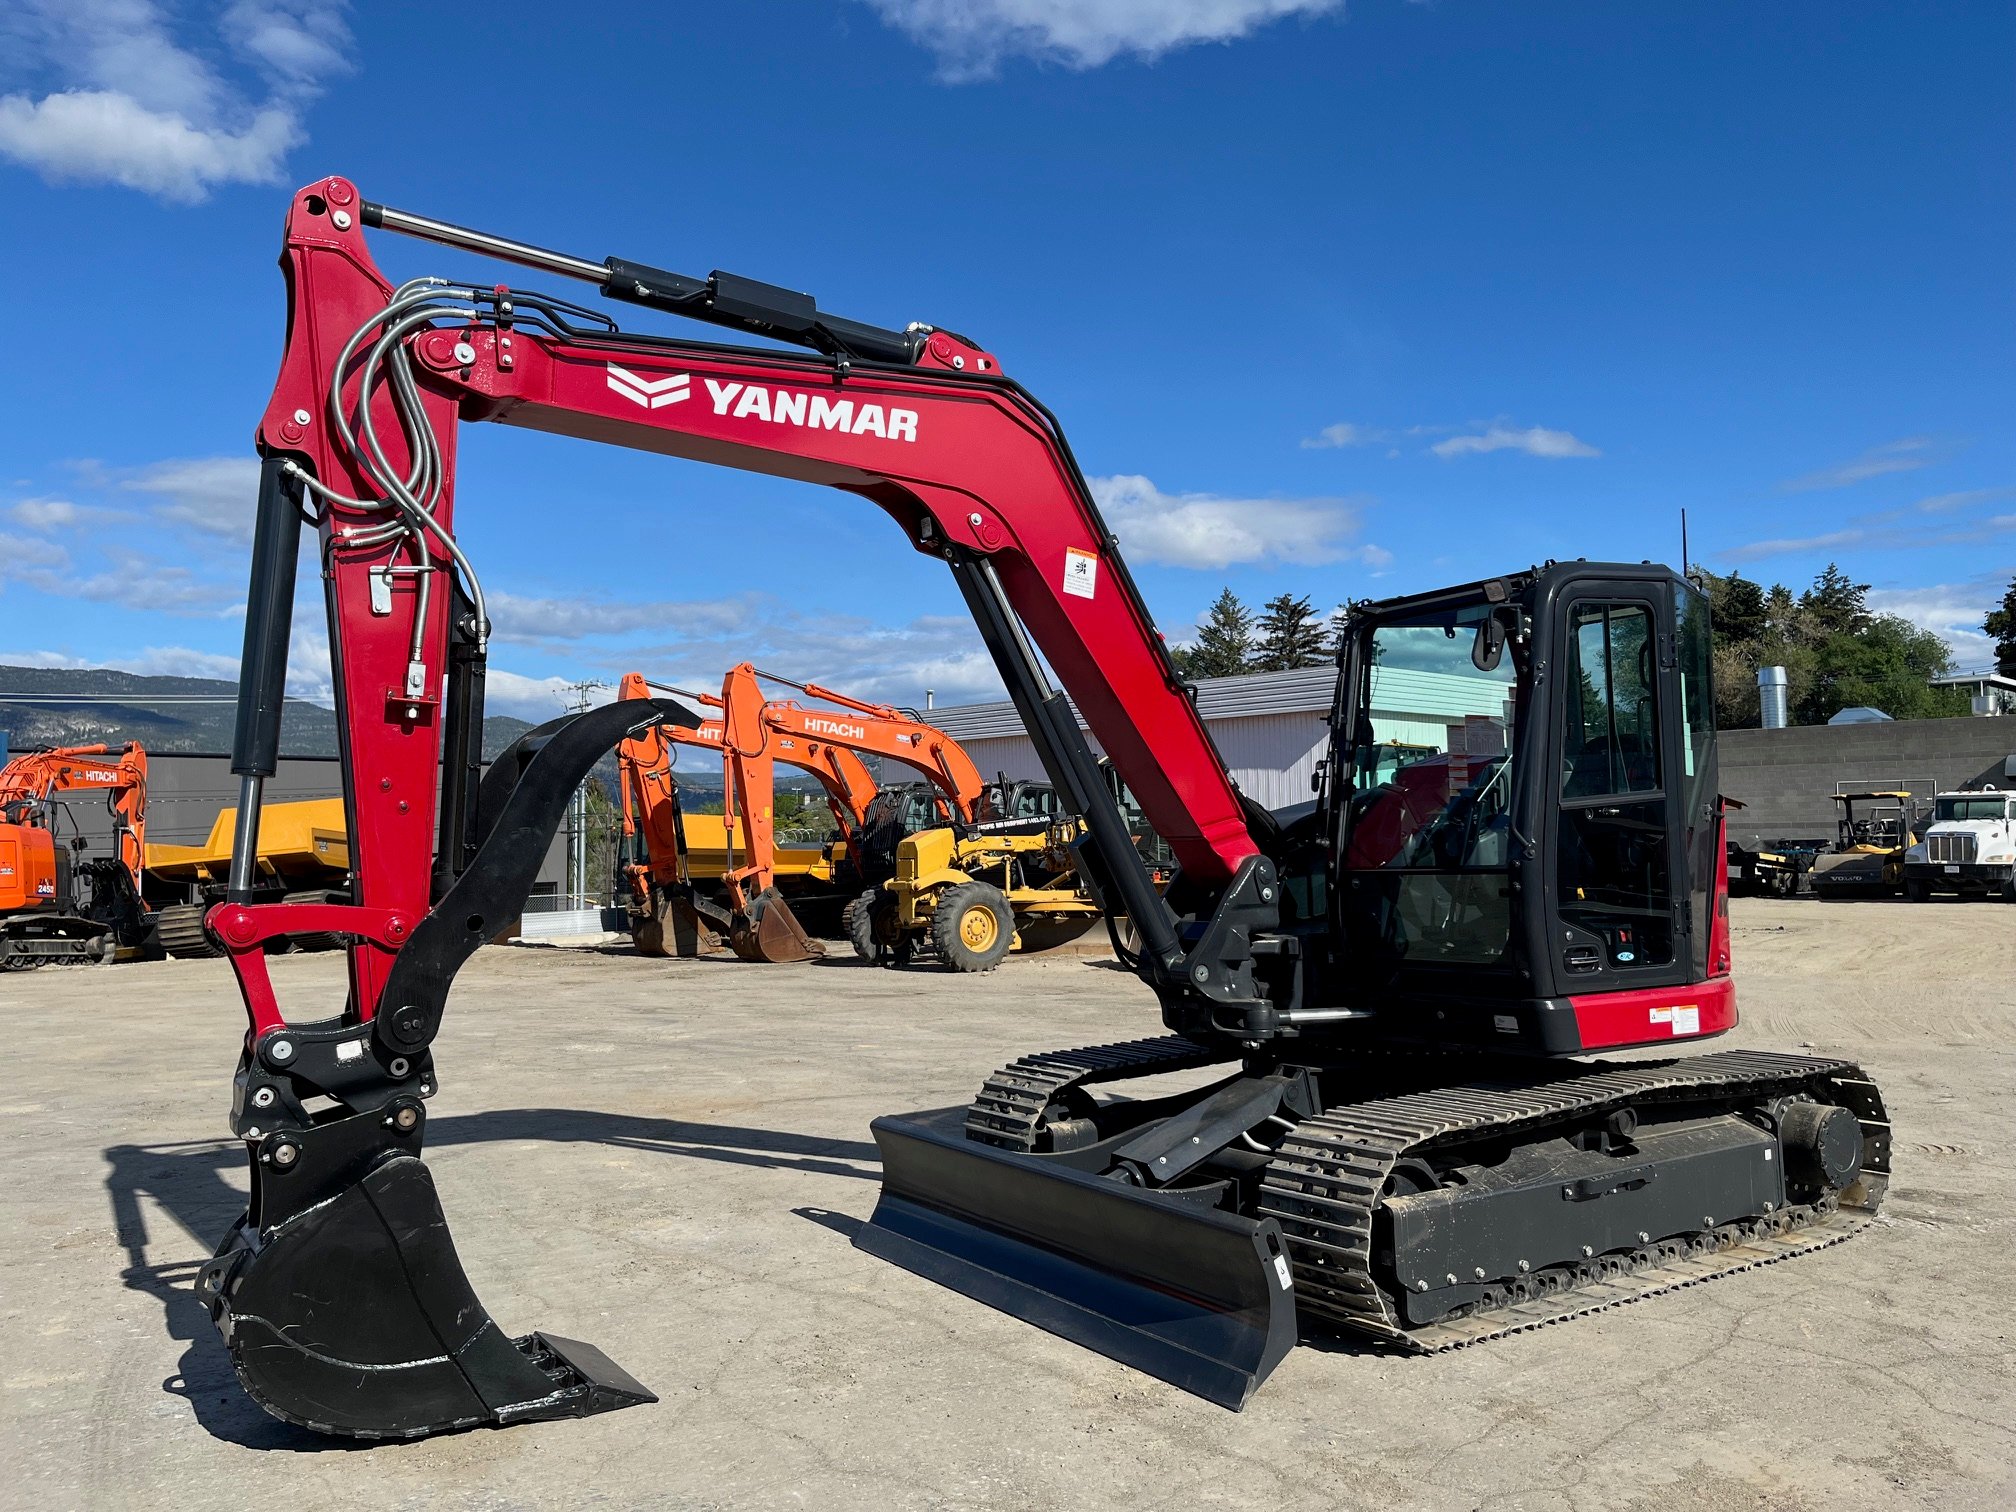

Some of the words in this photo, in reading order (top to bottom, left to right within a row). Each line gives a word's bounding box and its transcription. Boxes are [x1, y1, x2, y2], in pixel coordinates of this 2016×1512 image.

[704, 378, 919, 443] YANMAR
[804, 717, 865, 740] HITACHI
[85, 770, 118, 783] HITACHI
